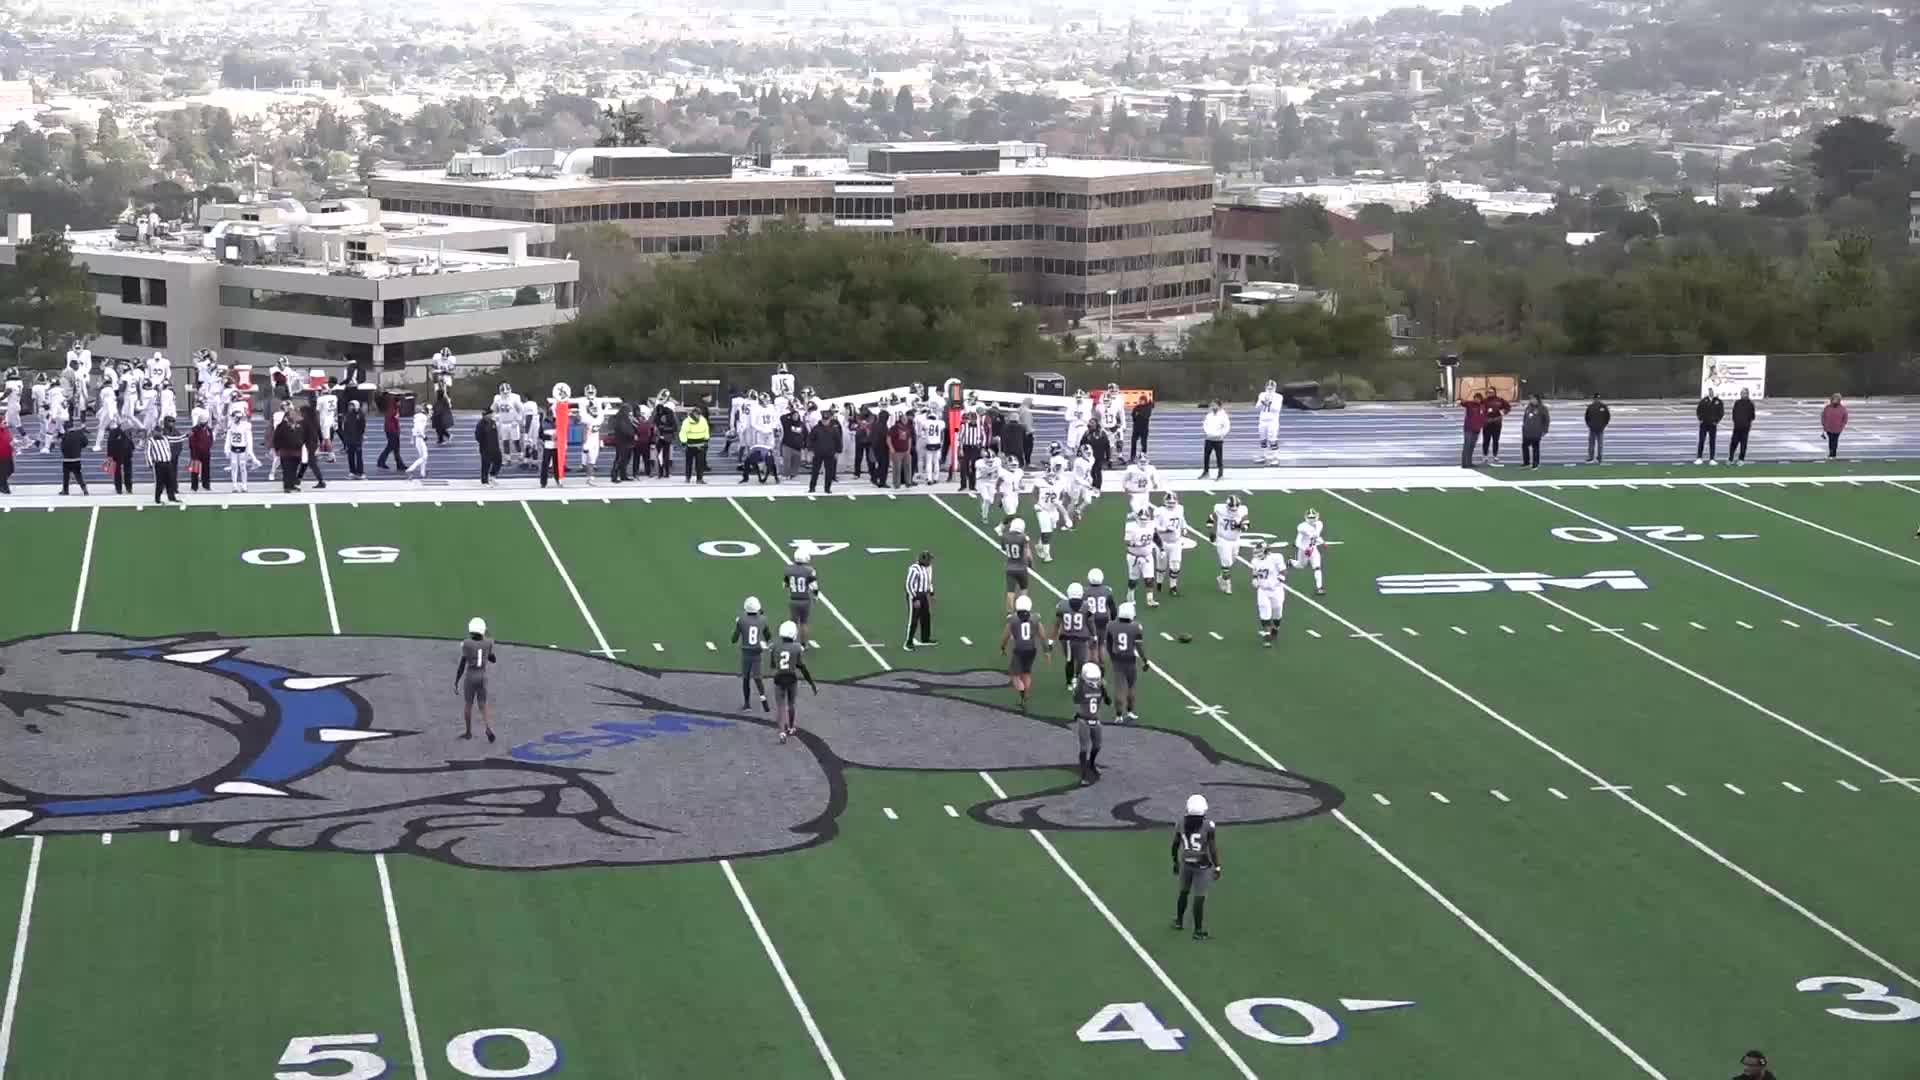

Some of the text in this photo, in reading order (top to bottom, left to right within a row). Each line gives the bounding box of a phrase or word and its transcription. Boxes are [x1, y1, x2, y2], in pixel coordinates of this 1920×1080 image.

[1006, 543, 1020, 559] 10
[789, 577, 806, 593] 40
[1063, 613, 1083, 630] 99
[748, 626, 758, 644] 8
[1021, 622, 1031, 640] 0
[1118, 633, 1128, 650] 9
[477, 648, 483, 667] 1
[779, 651, 790, 669] 2
[1089, 697, 1098, 714] 6
[1181, 832, 1202, 851] 15
[1075, 997, 1340, 1050] 40
[274, 1028, 557, 1080] 50
